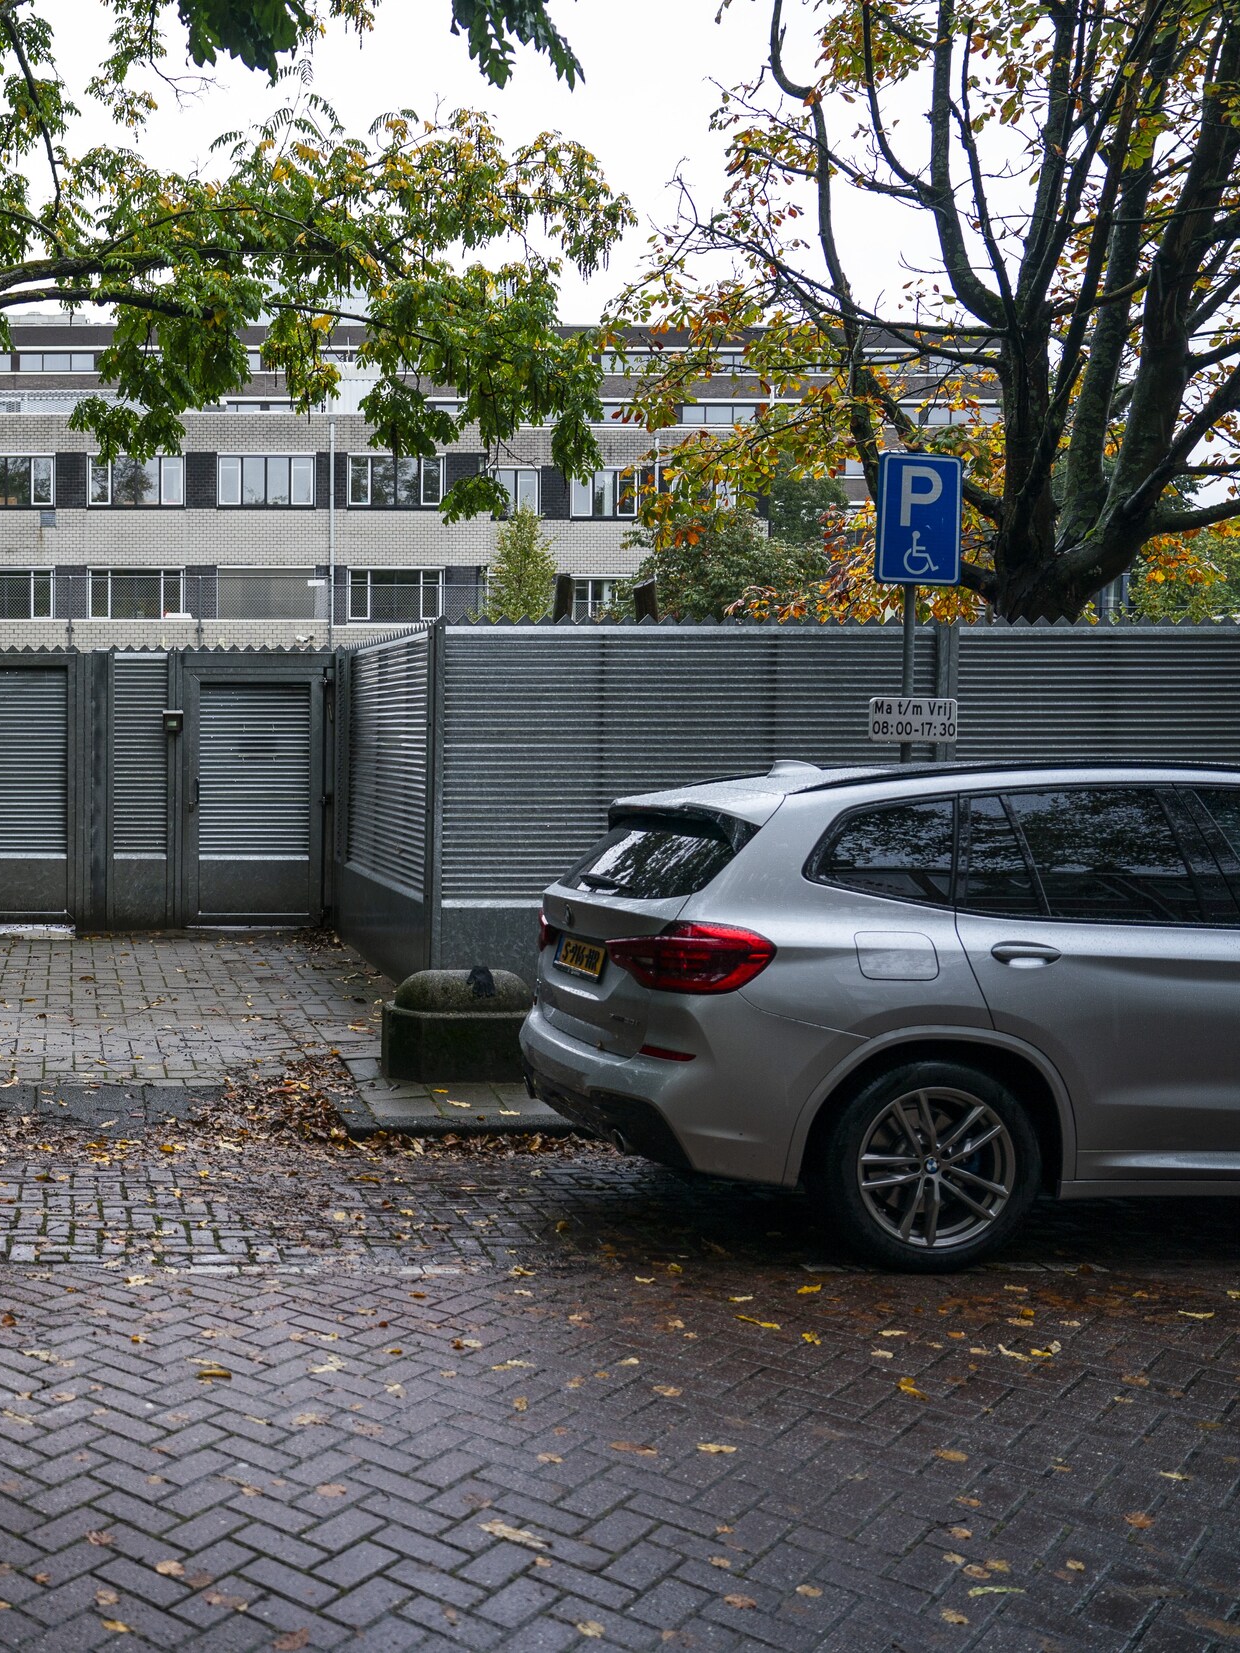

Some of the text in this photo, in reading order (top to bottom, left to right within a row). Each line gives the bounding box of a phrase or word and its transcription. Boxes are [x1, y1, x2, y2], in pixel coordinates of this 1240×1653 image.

[900, 465, 943, 527] P
[874, 700, 952, 720] Ma t/m Vrij
[872, 721, 956, 737] 08:00-17:30
